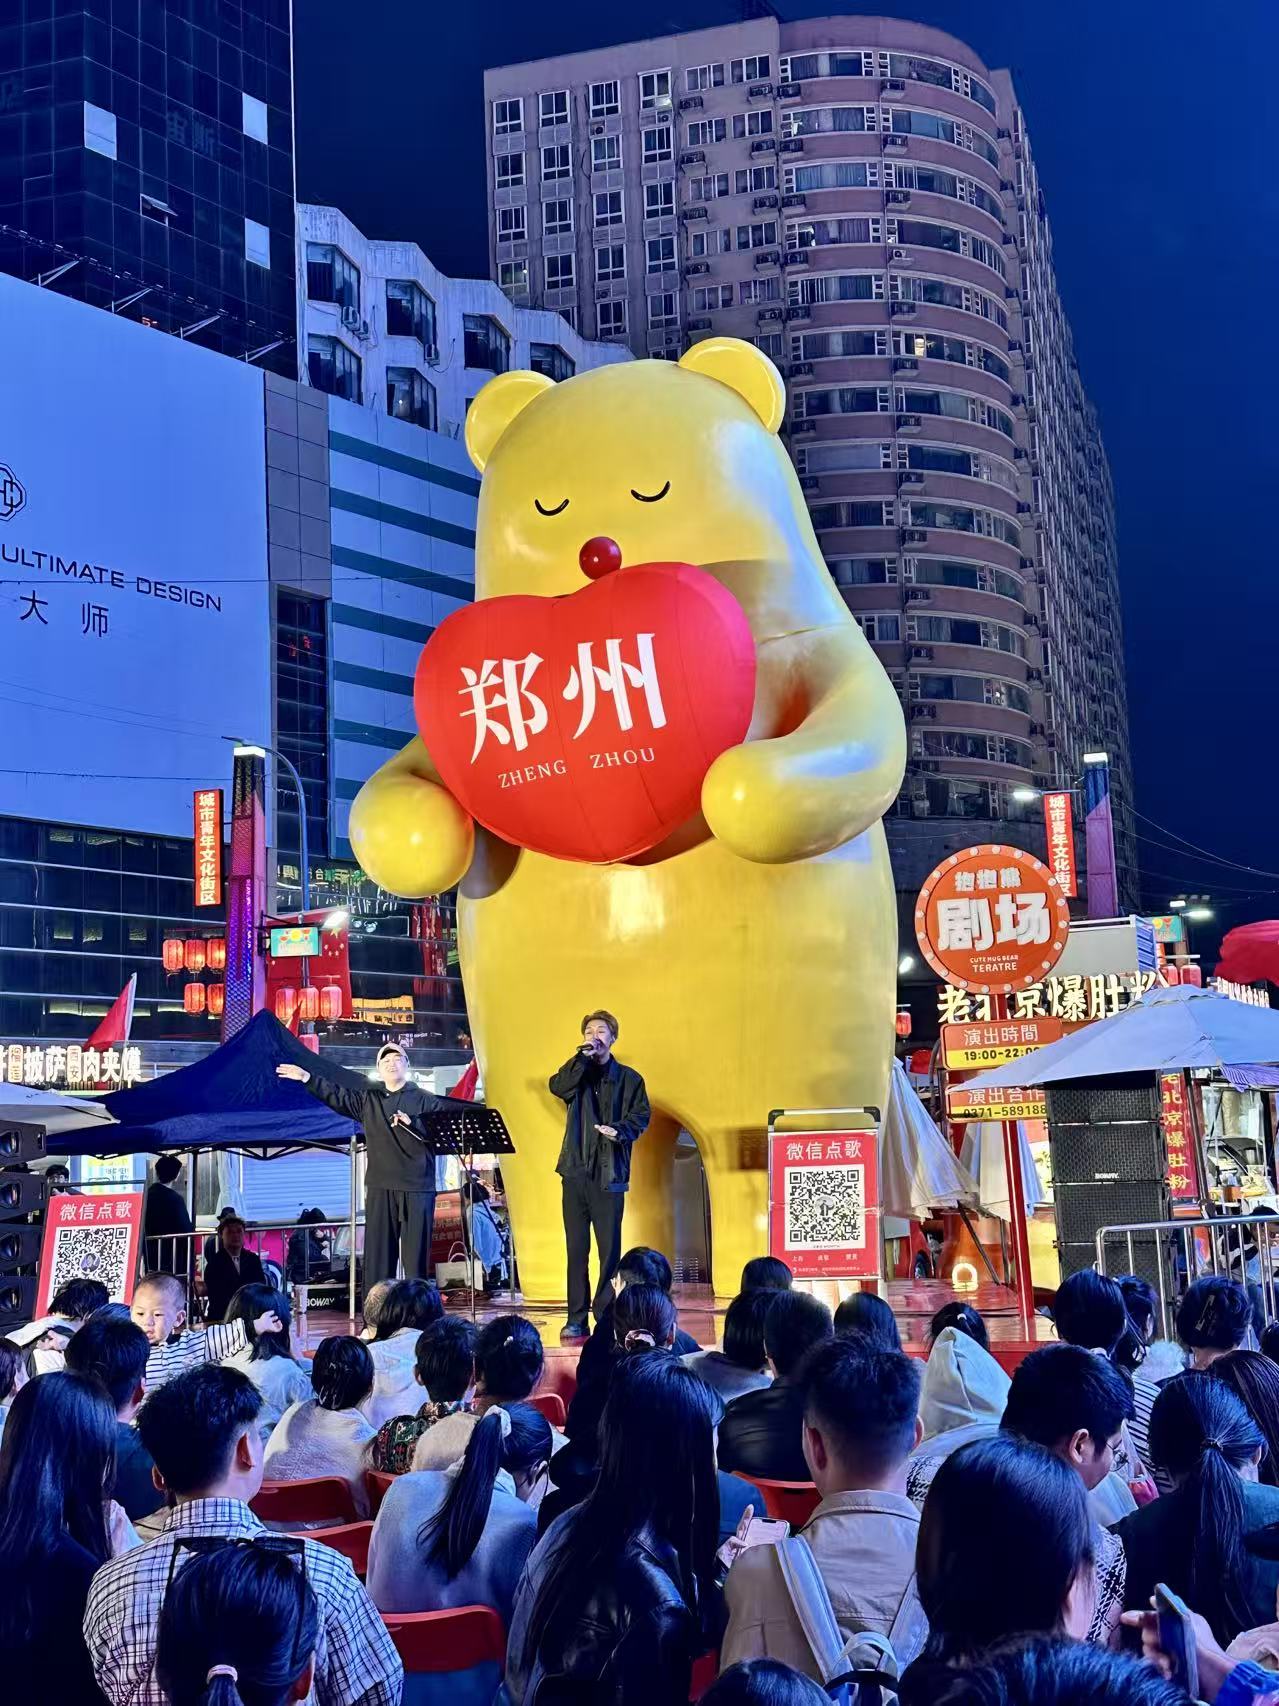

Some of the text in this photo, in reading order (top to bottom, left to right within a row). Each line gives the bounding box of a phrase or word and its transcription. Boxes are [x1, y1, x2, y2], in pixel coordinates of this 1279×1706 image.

[2, 544, 222, 612] ULTIMATE DESIGN
[19, 590, 109, 637] 大师
[458, 633, 668, 765] 郑州
[498, 747, 656, 788] ZHENG ZHOU
[199, 792, 216, 905] 城市青年文化街区
[936, 892, 1051, 952] 剧场
[972, 962, 1018, 974] TERATRE
[786, 1140, 862, 1160] 微信点歌
[60, 1201, 132, 1221] 微信点歌
